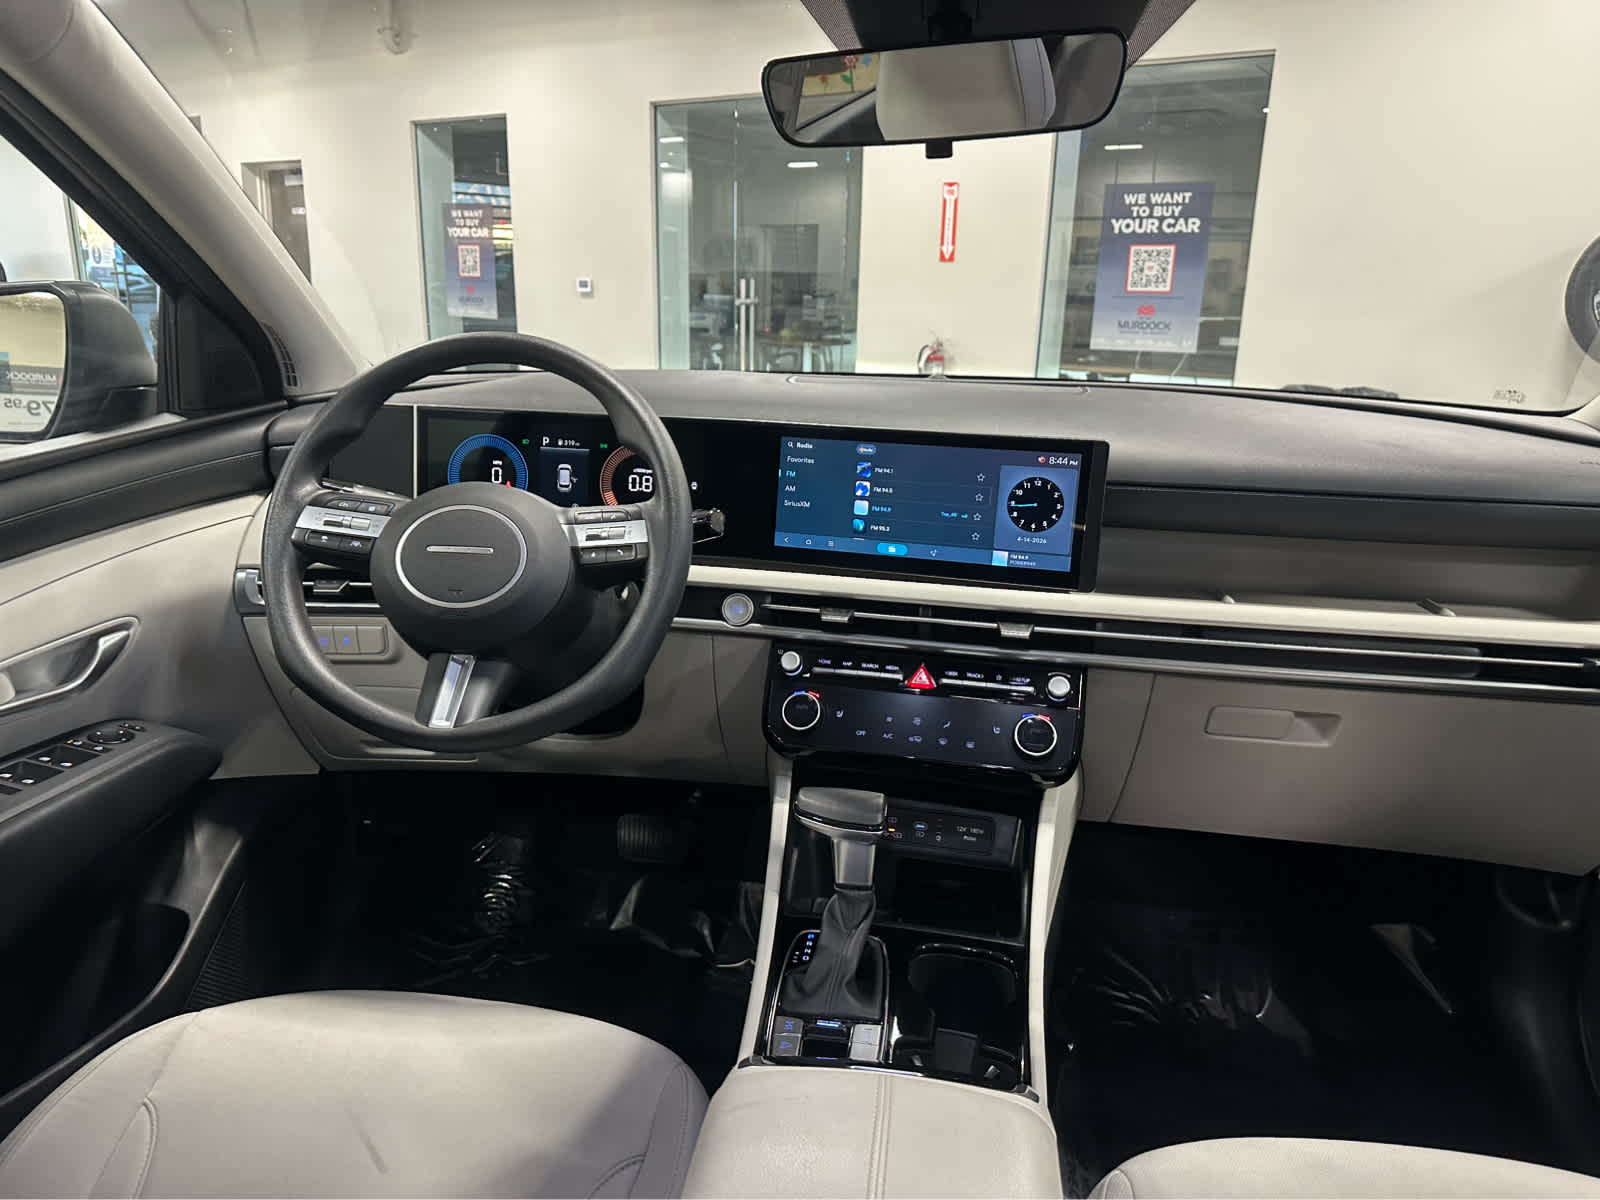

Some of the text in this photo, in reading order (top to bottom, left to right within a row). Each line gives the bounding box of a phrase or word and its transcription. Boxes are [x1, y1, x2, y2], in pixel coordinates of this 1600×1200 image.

[1124, 192, 1193, 205] WE WANT
[451, 210, 483, 218] WE WANT
[1131, 206, 1183, 217] TO BUY
[456, 218, 465, 226] TO
[1111, 218, 1201, 234] YOUR CAR
[447, 227, 489, 237] YOUR CAR
[1117, 320, 1171, 331] MURDOCK
[542, 436, 550, 446] P
[786, 456, 815, 464] Favorites
[1048, 456, 1068, 465] 8:44
[491, 467, 502, 484] 0
[628, 474, 653, 492] 0.8
[783, 500, 811, 508] SiriusXM
